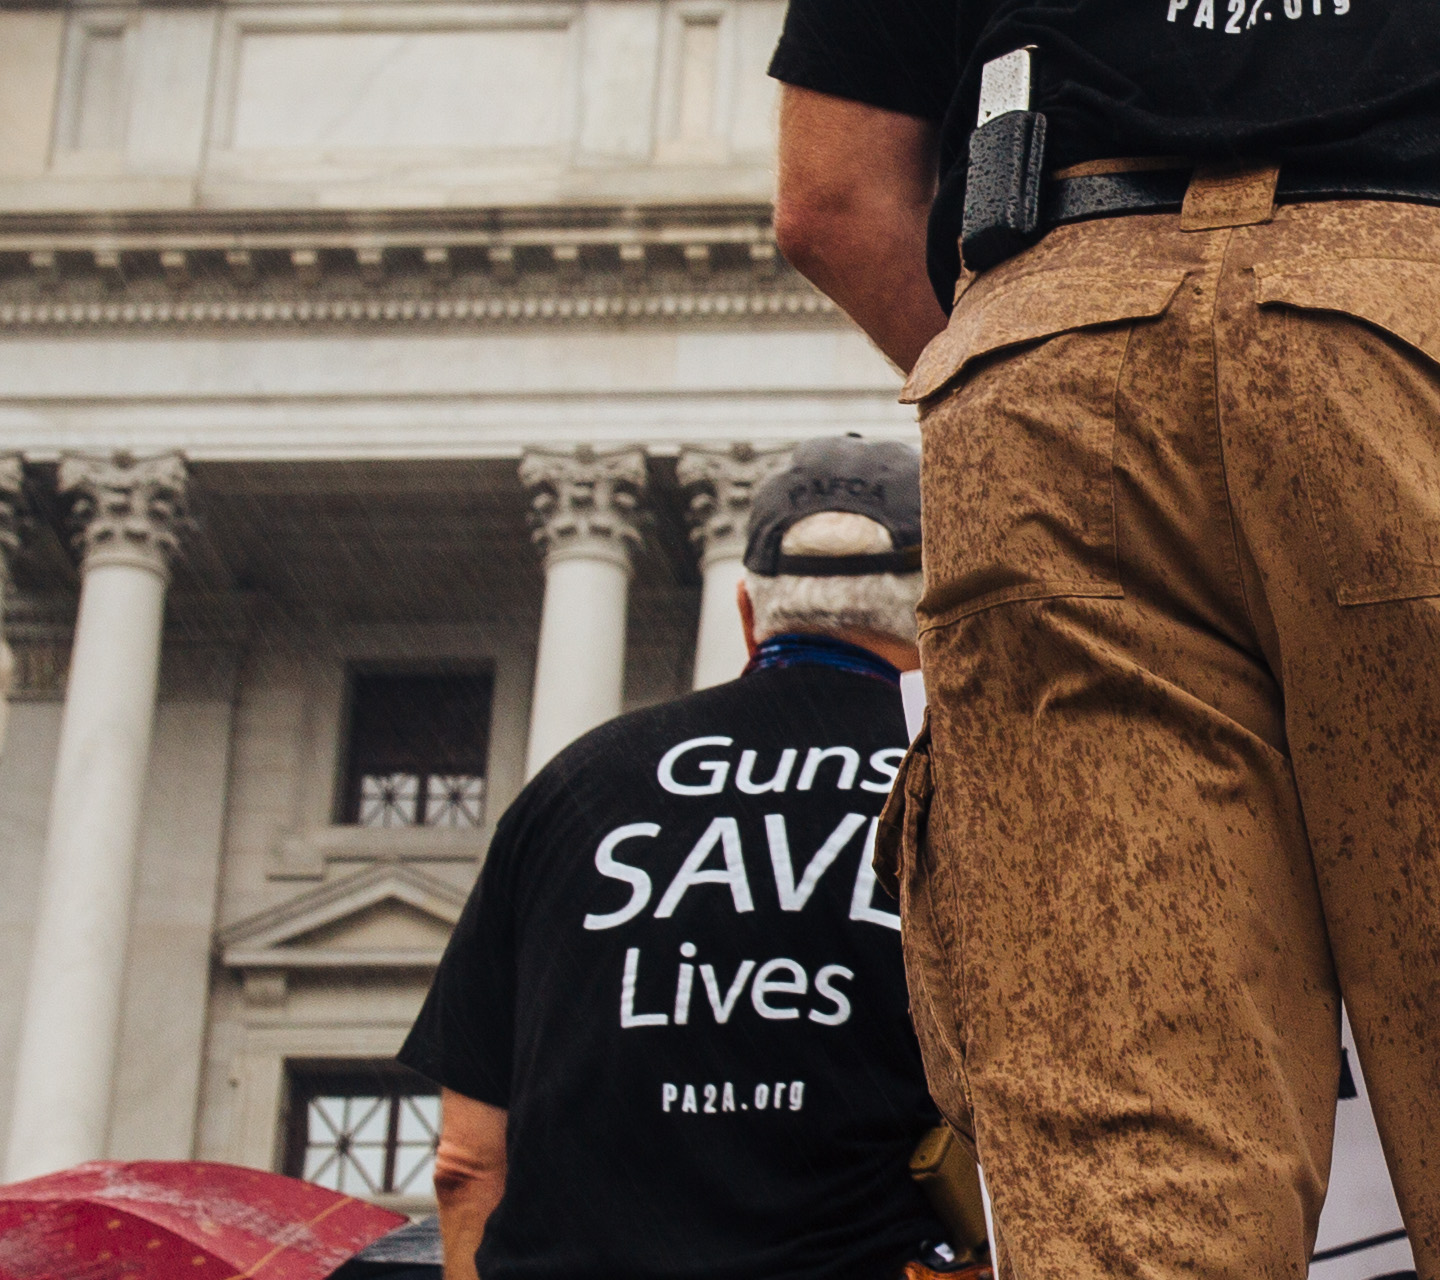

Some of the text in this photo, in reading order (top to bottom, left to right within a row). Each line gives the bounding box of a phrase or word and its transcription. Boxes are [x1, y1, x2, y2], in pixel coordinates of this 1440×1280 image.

[657, 735, 910, 797] Guns
[620, 941, 855, 1028] Lives
[661, 1080, 806, 1114] PA2A.org
